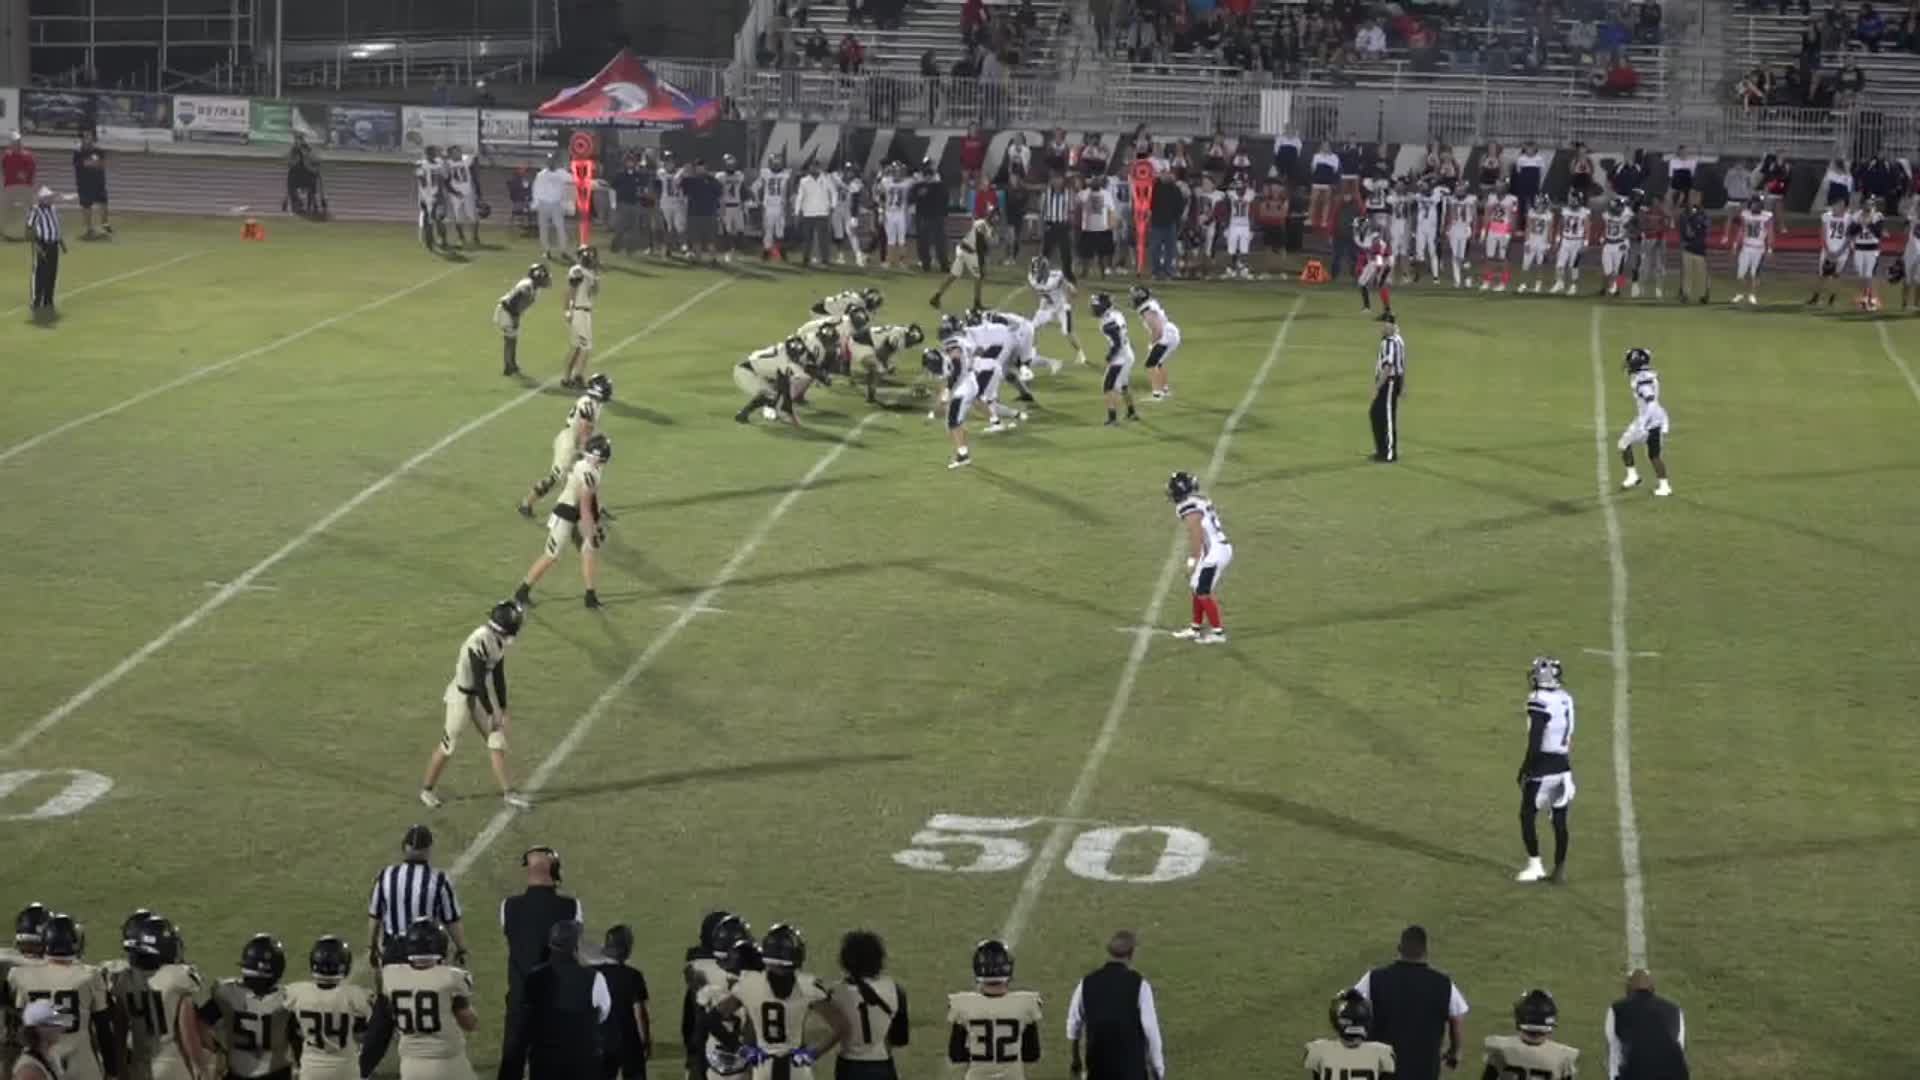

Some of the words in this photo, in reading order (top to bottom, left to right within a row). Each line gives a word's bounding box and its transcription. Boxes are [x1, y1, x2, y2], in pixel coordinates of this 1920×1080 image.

[892, 814, 1210, 882] 50
[126, 990, 168, 1035] 41
[233, 1011, 272, 1050] 51
[300, 1011, 348, 1049] 34
[761, 1001, 787, 1044] 8
[968, 1018, 1020, 1062] 32
